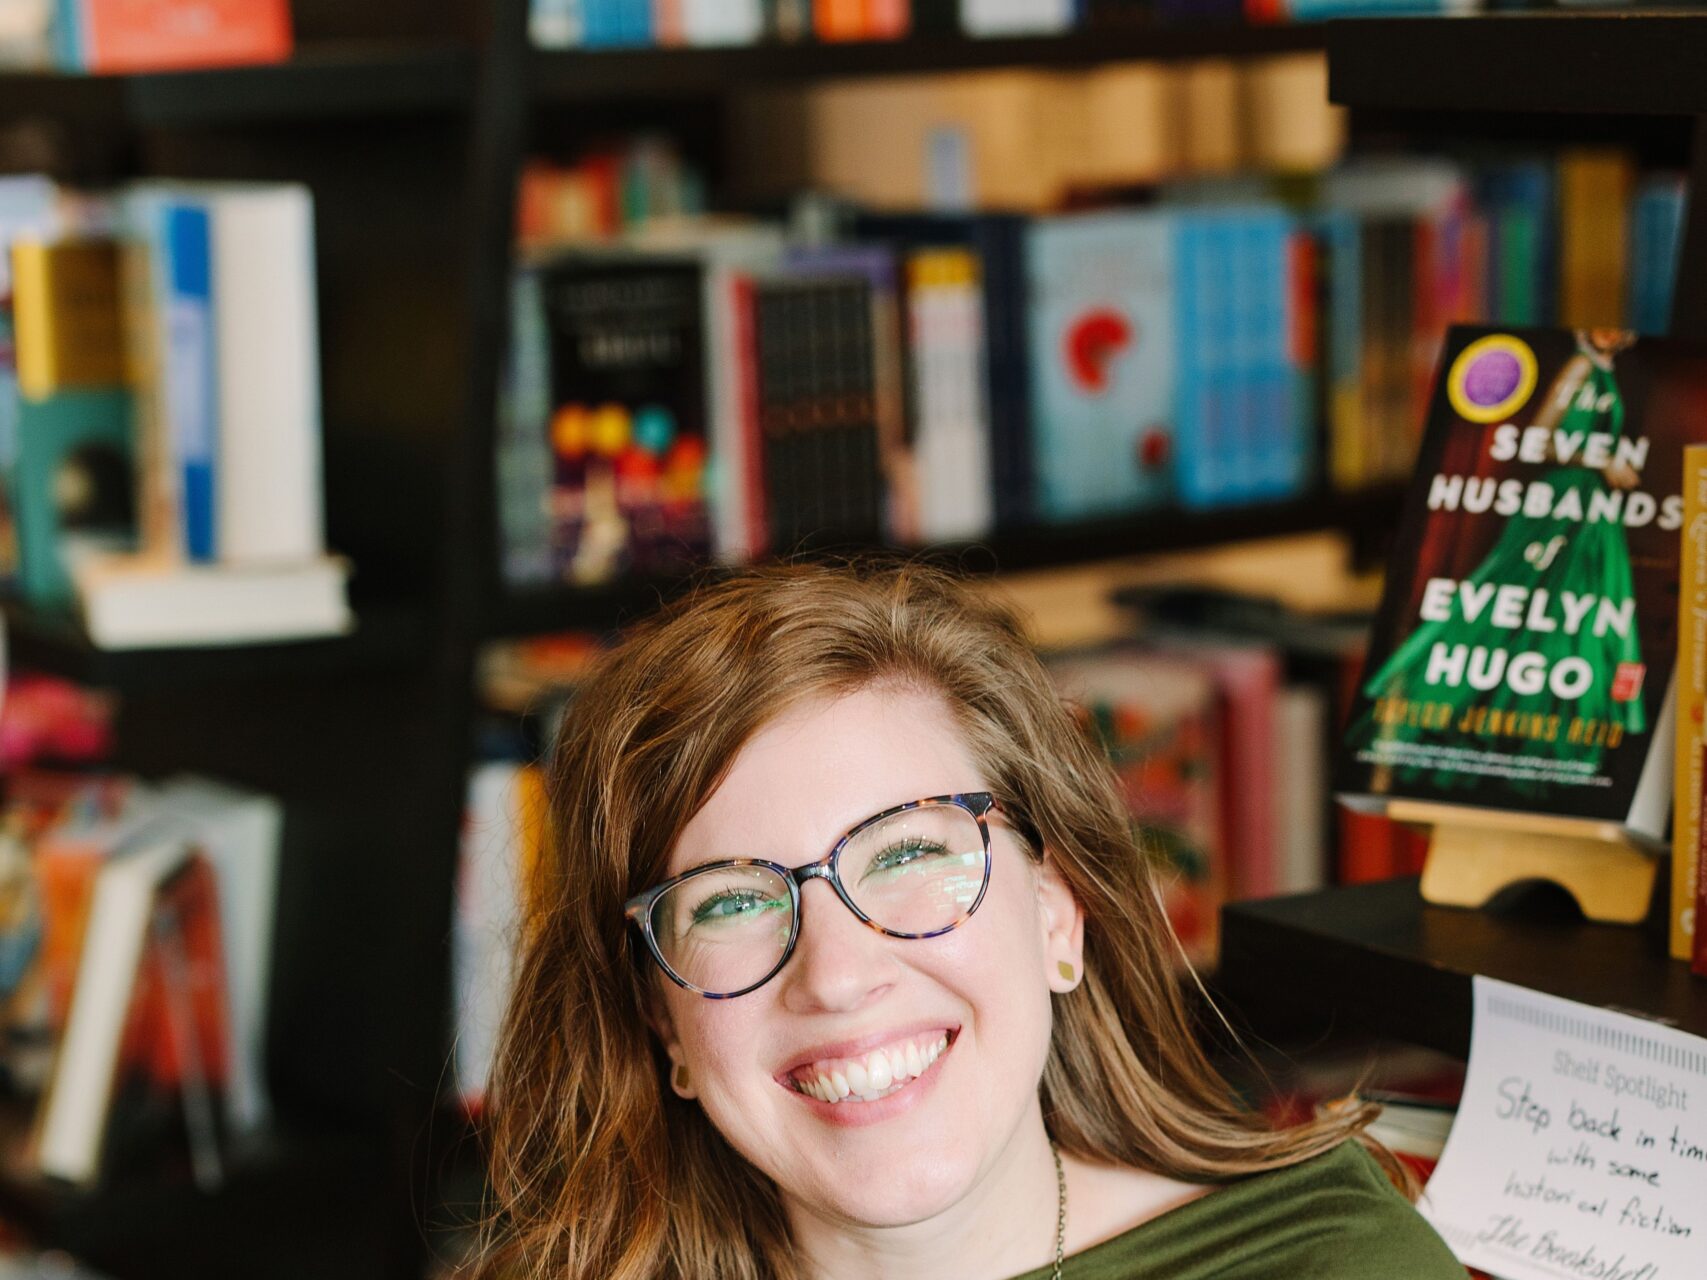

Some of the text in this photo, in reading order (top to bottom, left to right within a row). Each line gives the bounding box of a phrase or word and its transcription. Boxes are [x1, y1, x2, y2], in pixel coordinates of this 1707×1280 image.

[1490, 424, 1650, 471] SEVEN
[1428, 474, 1684, 530] HUSBANDS
[1523, 536, 1567, 571] of
[1420, 578, 1635, 638] EVELYN
[1425, 642, 1593, 699] HUGO
[1553, 1049, 1687, 1110] Shelf Spotlight
[1496, 1076, 1550, 1134] Step
[1568, 1099, 1620, 1141] back
[1636, 1130, 1655, 1147] in
[1547, 1141, 1660, 1187] with some
[1477, 1213, 1530, 1249] The
[1618, 1195, 1691, 1238] fiction
